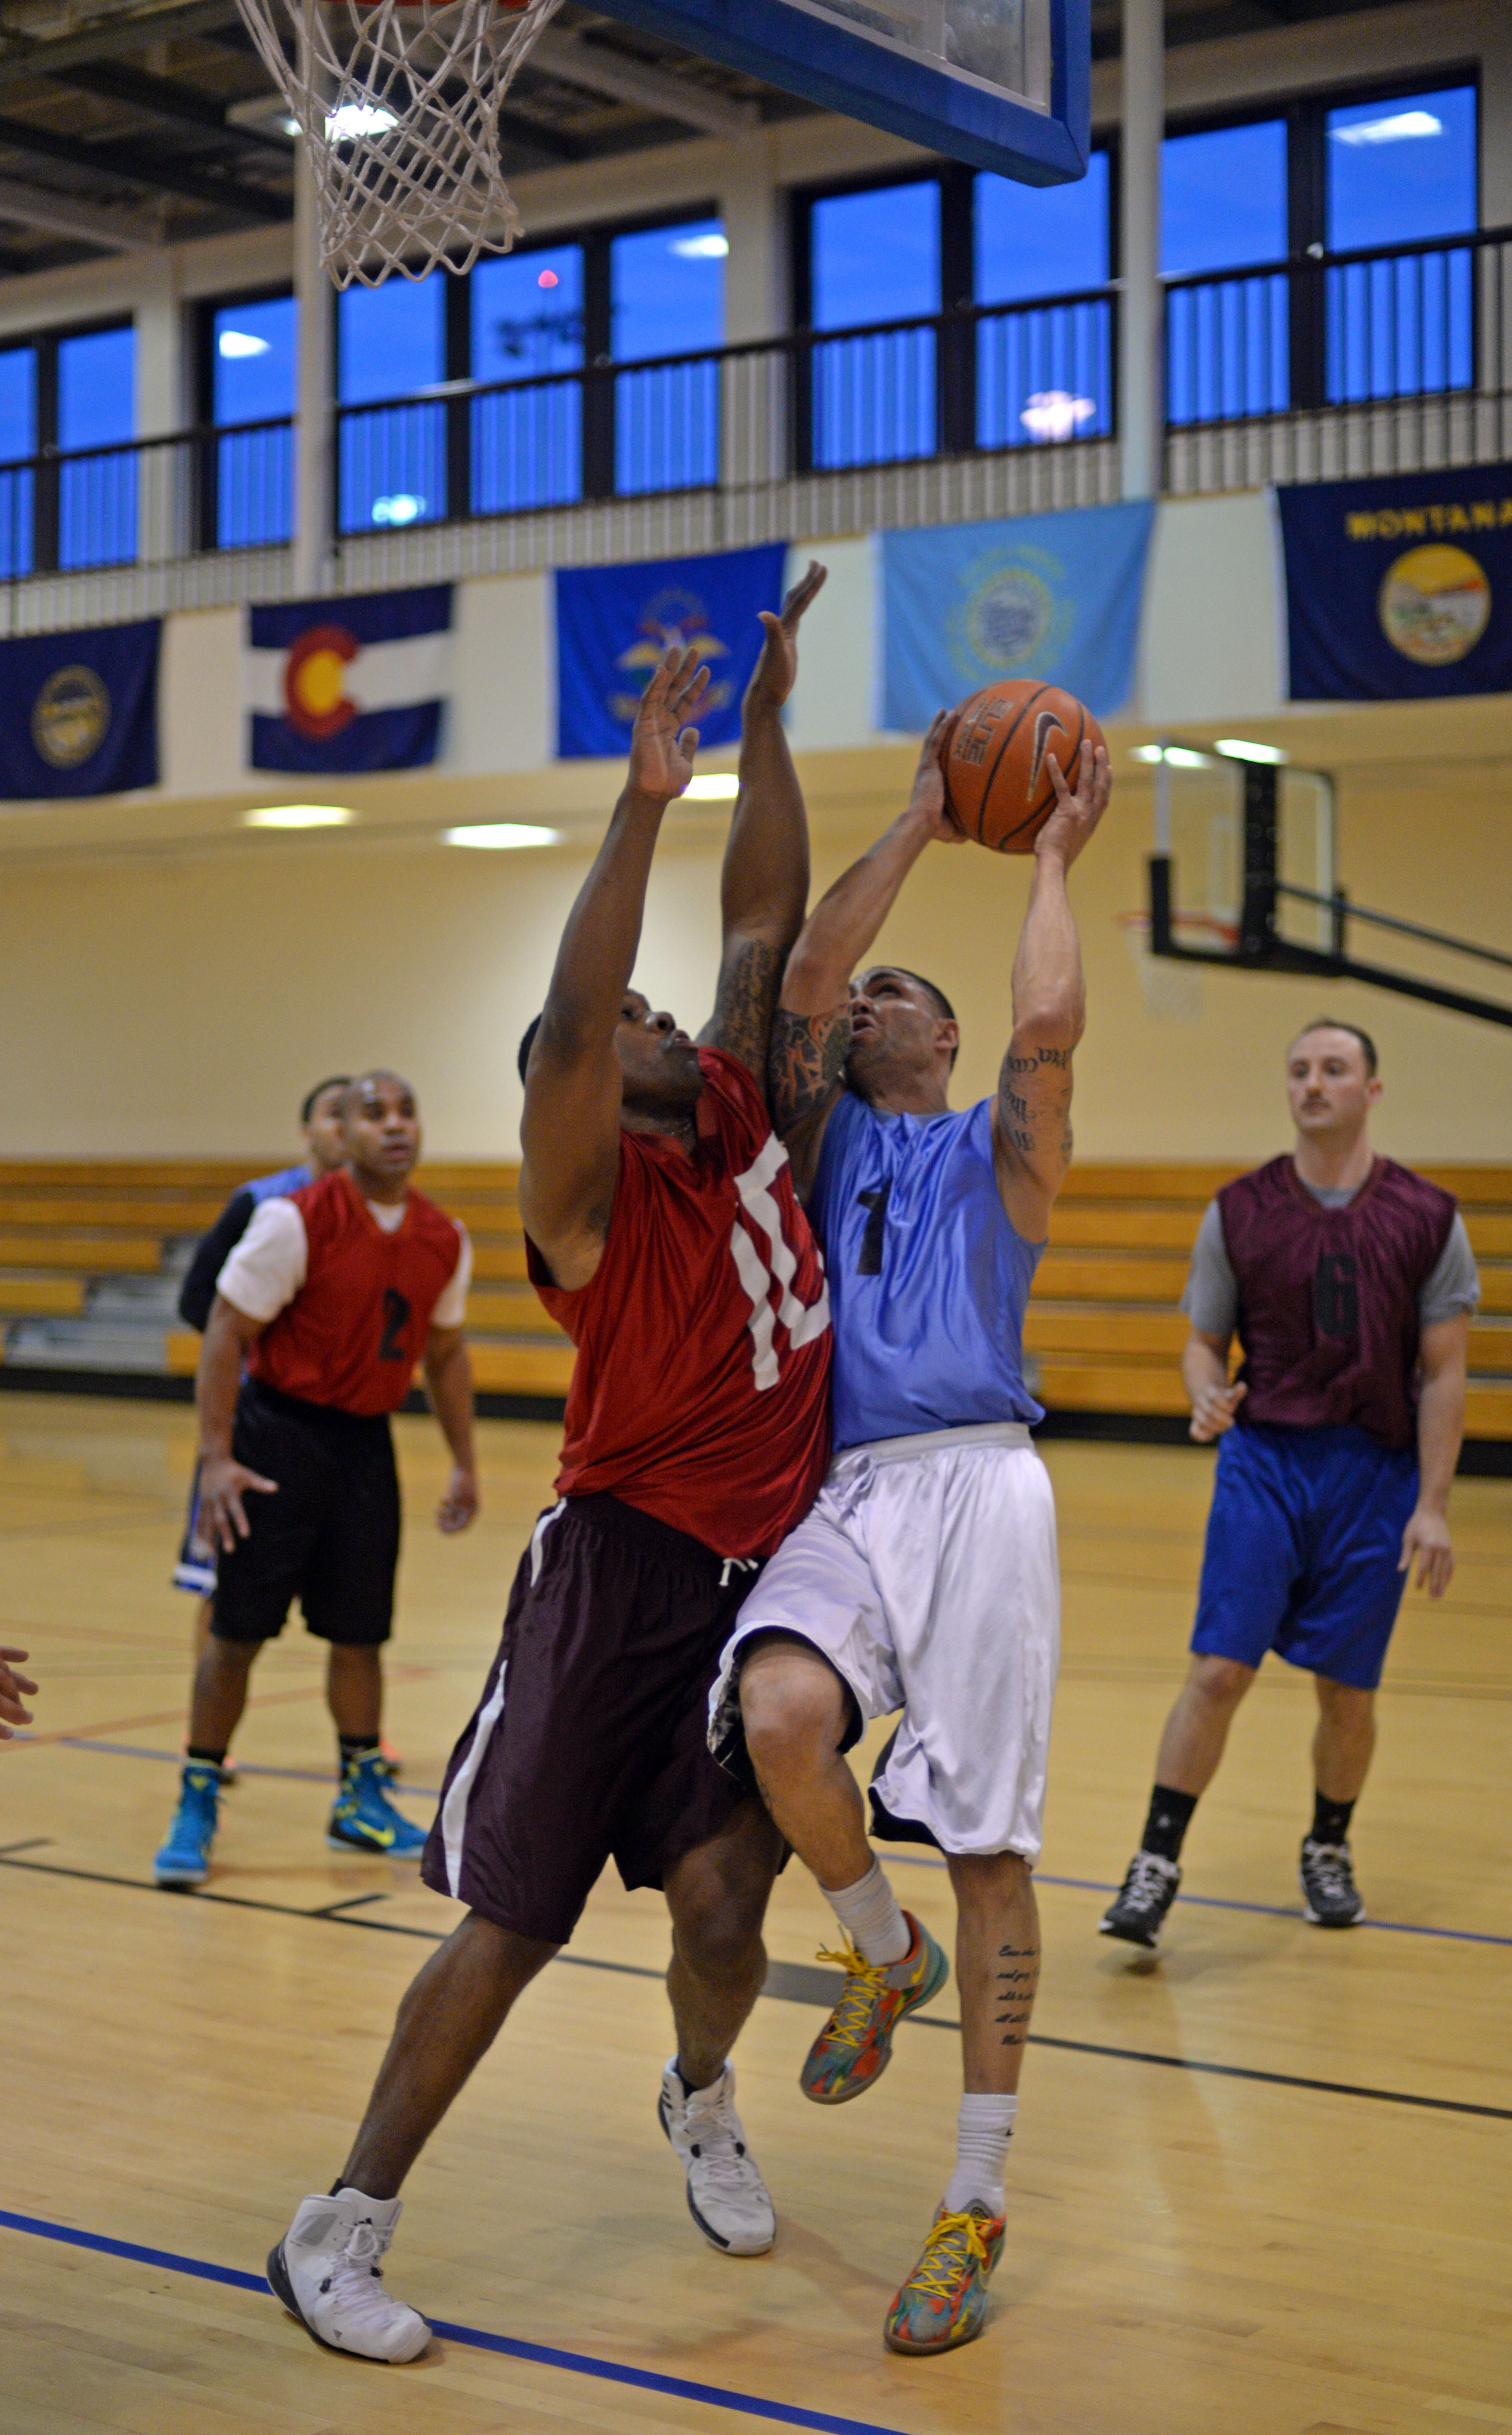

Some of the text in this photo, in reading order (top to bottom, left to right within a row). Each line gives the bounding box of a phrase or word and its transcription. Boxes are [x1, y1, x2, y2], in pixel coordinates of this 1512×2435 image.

[857, 1176, 894, 1275] 1
[378, 1287, 411, 1360] 2
[1317, 1252, 1358, 1335] 6
